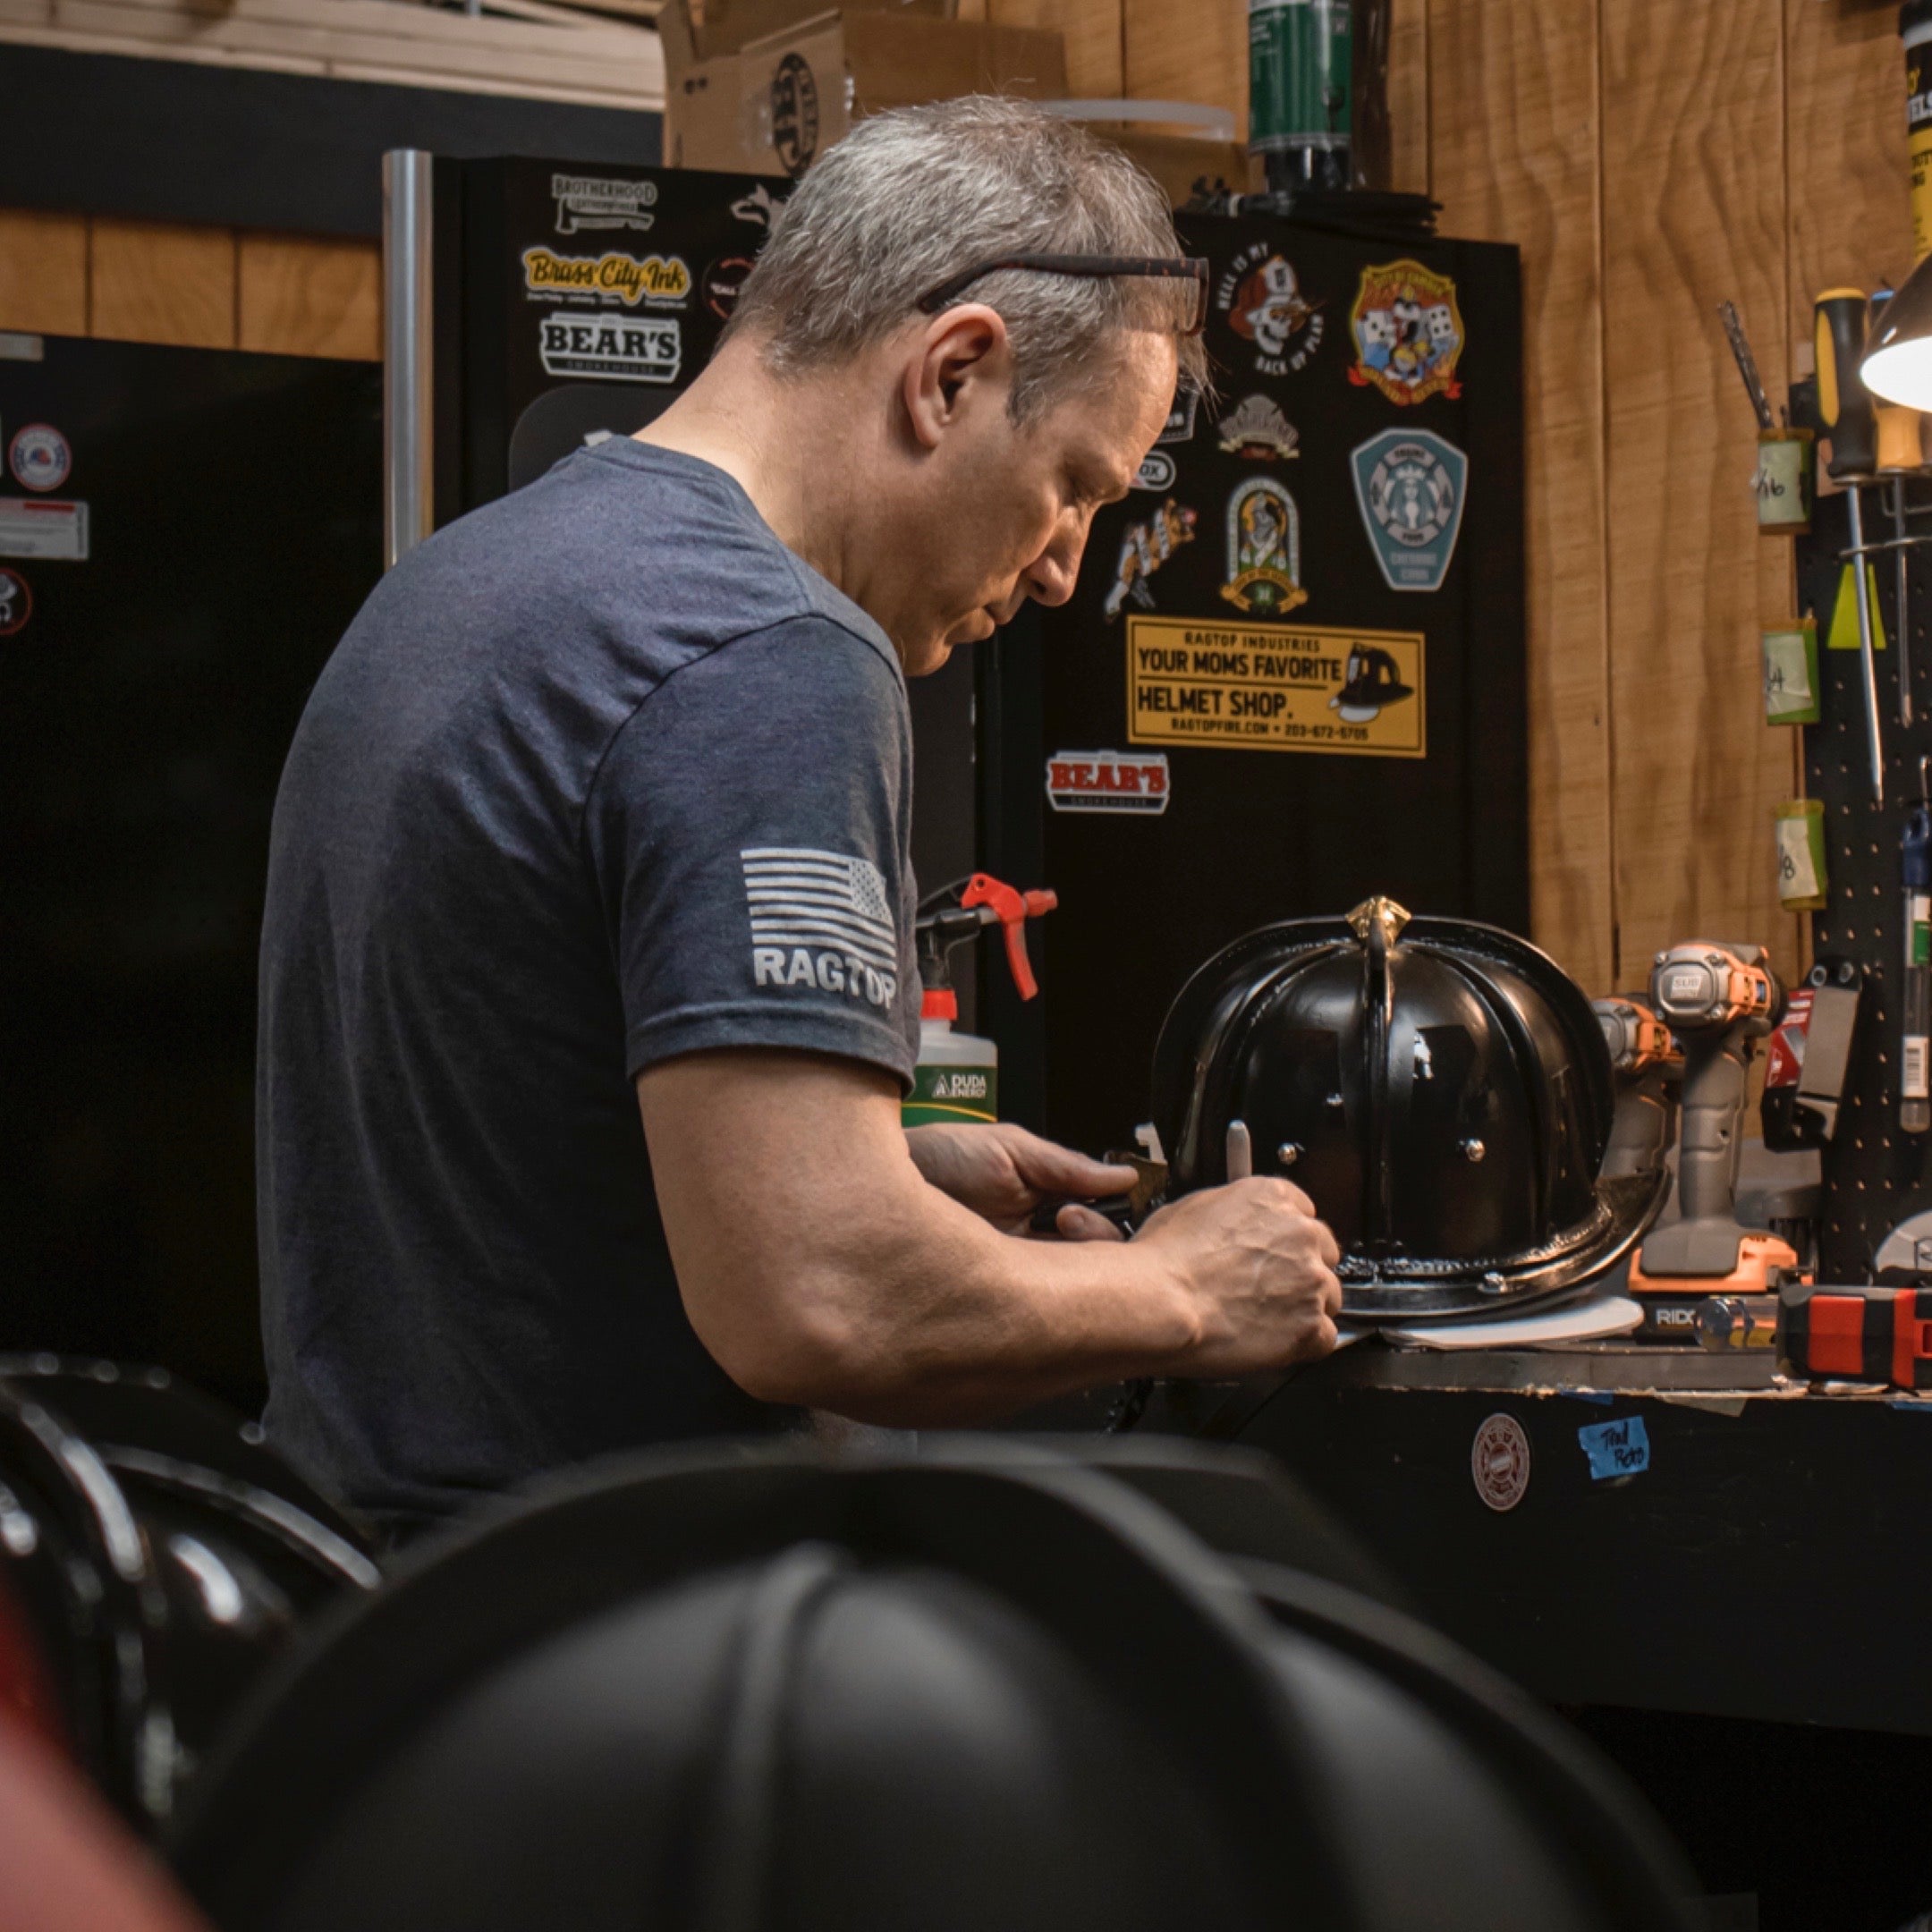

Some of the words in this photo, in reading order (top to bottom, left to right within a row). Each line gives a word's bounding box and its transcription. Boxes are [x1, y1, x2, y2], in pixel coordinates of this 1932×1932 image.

[555, 175, 655, 205] BROTHERHOOD
[530, 255, 594, 284] Brass
[600, 259, 640, 297] City
[646, 261, 682, 291] Ink
[544, 325, 677, 360] BEAR'S
[1184, 631, 1237, 647] RAGTOP
[1242, 636, 1320, 653] INDUSTRIES
[1139, 648, 1188, 672] YOUR
[1193, 651, 1249, 675] MOMS
[1254, 654, 1342, 682] FAVORITE
[1138, 686, 1223, 715] HELMET
[1229, 691, 1293, 719] SHOP.
[1171, 717, 1269, 734] RAGTOPFIRE.COM
[753, 946, 897, 1010] RAGTOP
